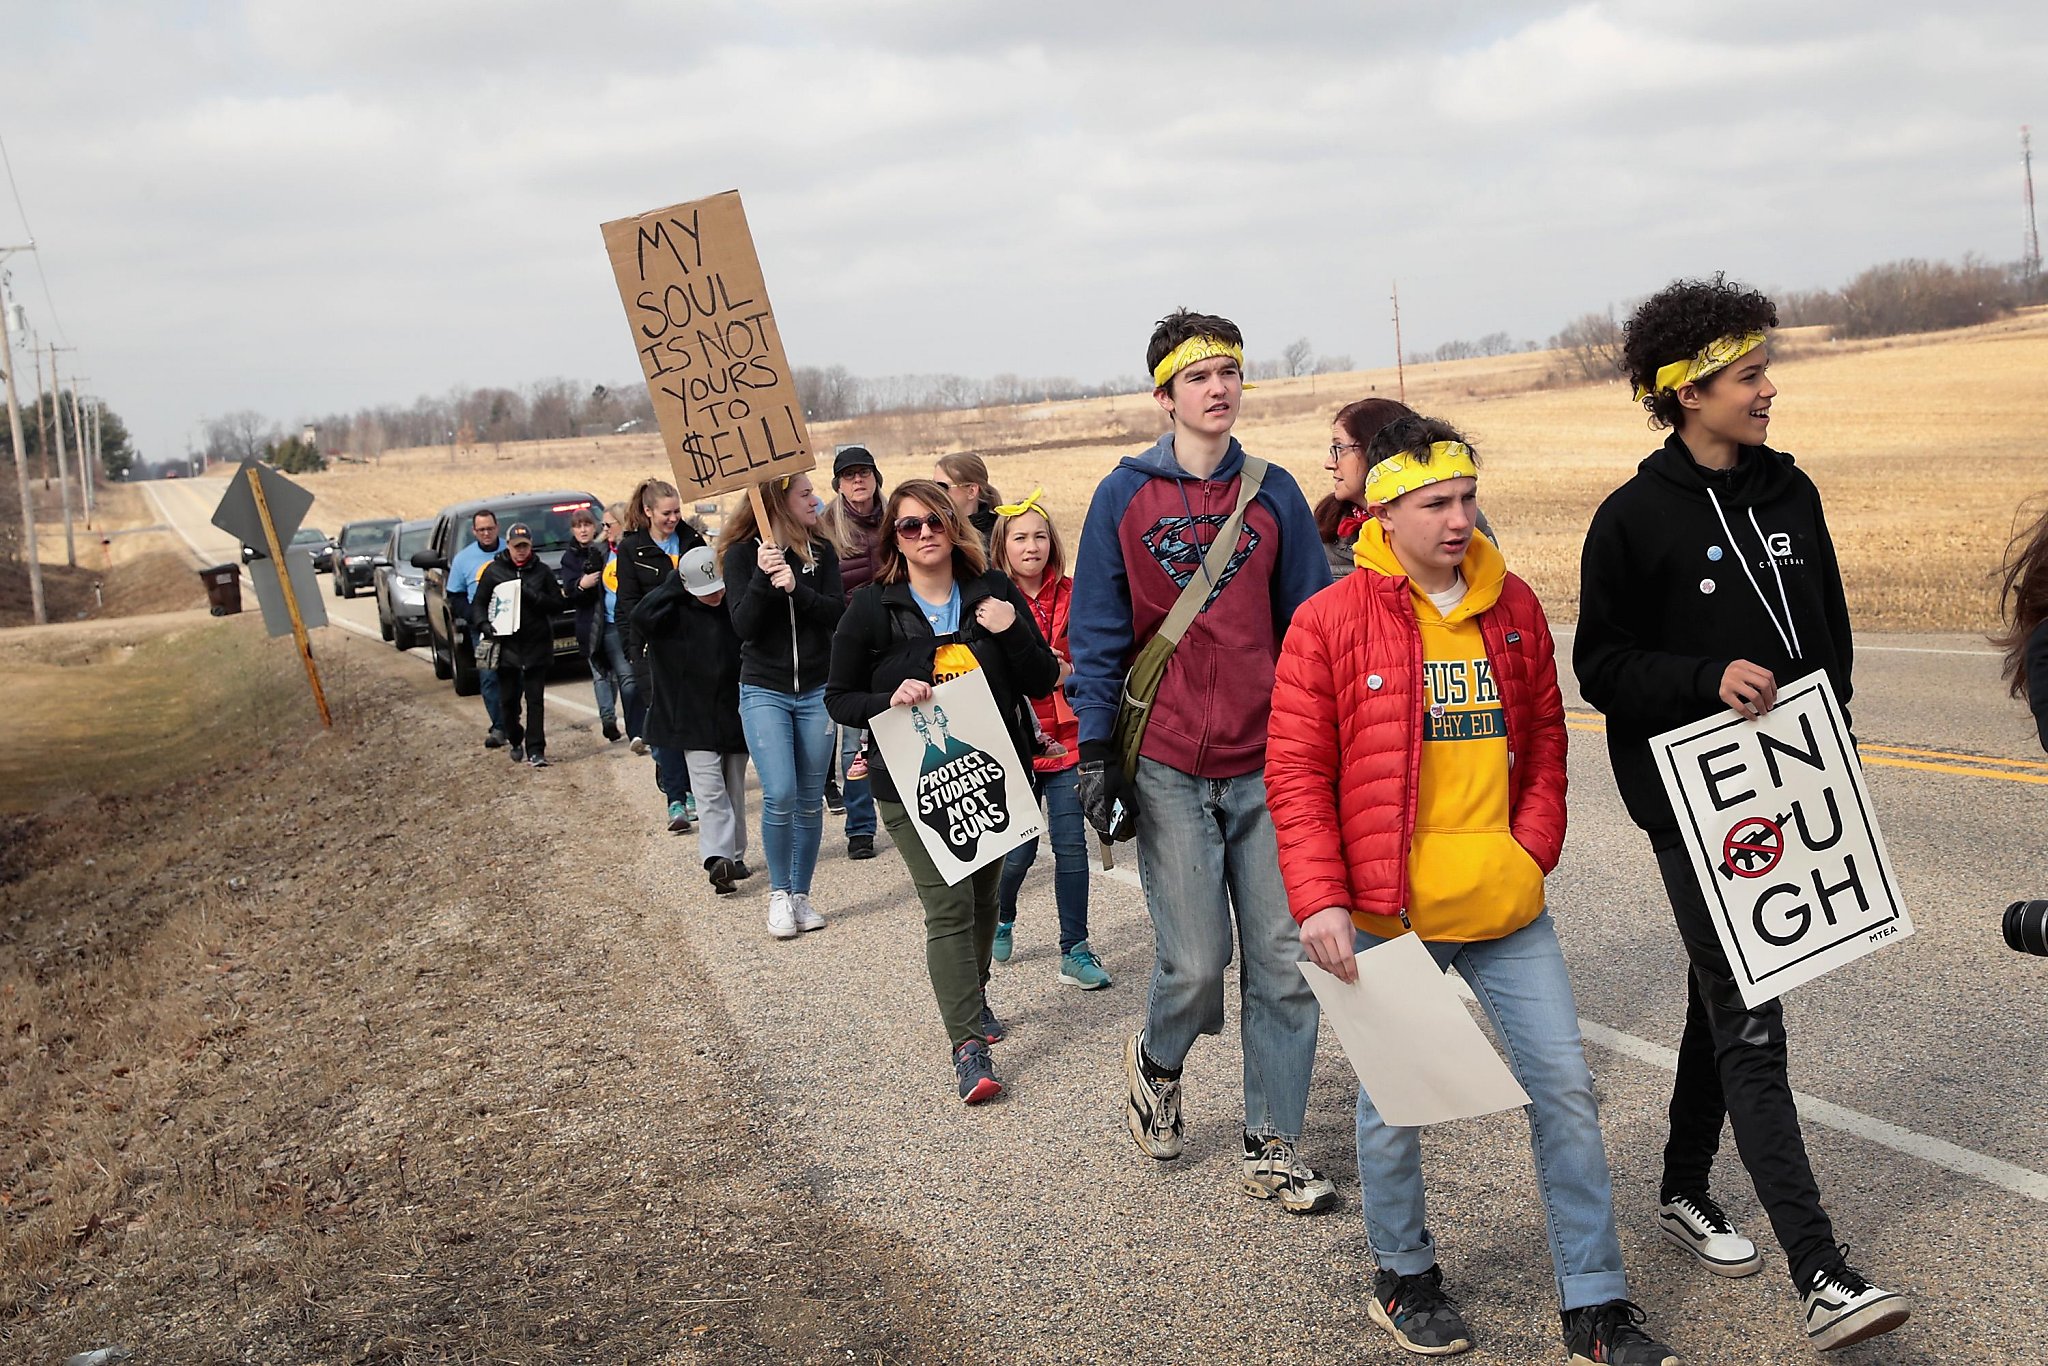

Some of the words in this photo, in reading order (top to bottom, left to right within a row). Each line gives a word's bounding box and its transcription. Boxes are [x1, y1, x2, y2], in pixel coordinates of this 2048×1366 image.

[637, 209, 702, 281] MY
[636, 273, 754, 339] SOUL
[641, 335, 692, 380] IS
[697, 311, 769, 369] NOT
[661, 355, 779, 427] YOURS
[697, 399, 751, 428] TO
[682, 405, 806, 488] $ELL!
[1758, 557, 1805, 569] CYLEBAR
[1472, 658, 1500, 704] K
[1431, 714, 1466, 738] PHY.
[1470, 712, 1499, 737] ED.
[919, 750, 987, 795] PROTECT
[920, 762, 1004, 815] STUDENTS
[946, 788, 991, 825] NOT
[949, 803, 1006, 846] GUNS
[1019, 825, 1039, 839] MTEA
[1868, 925, 1898, 944] MTEA
